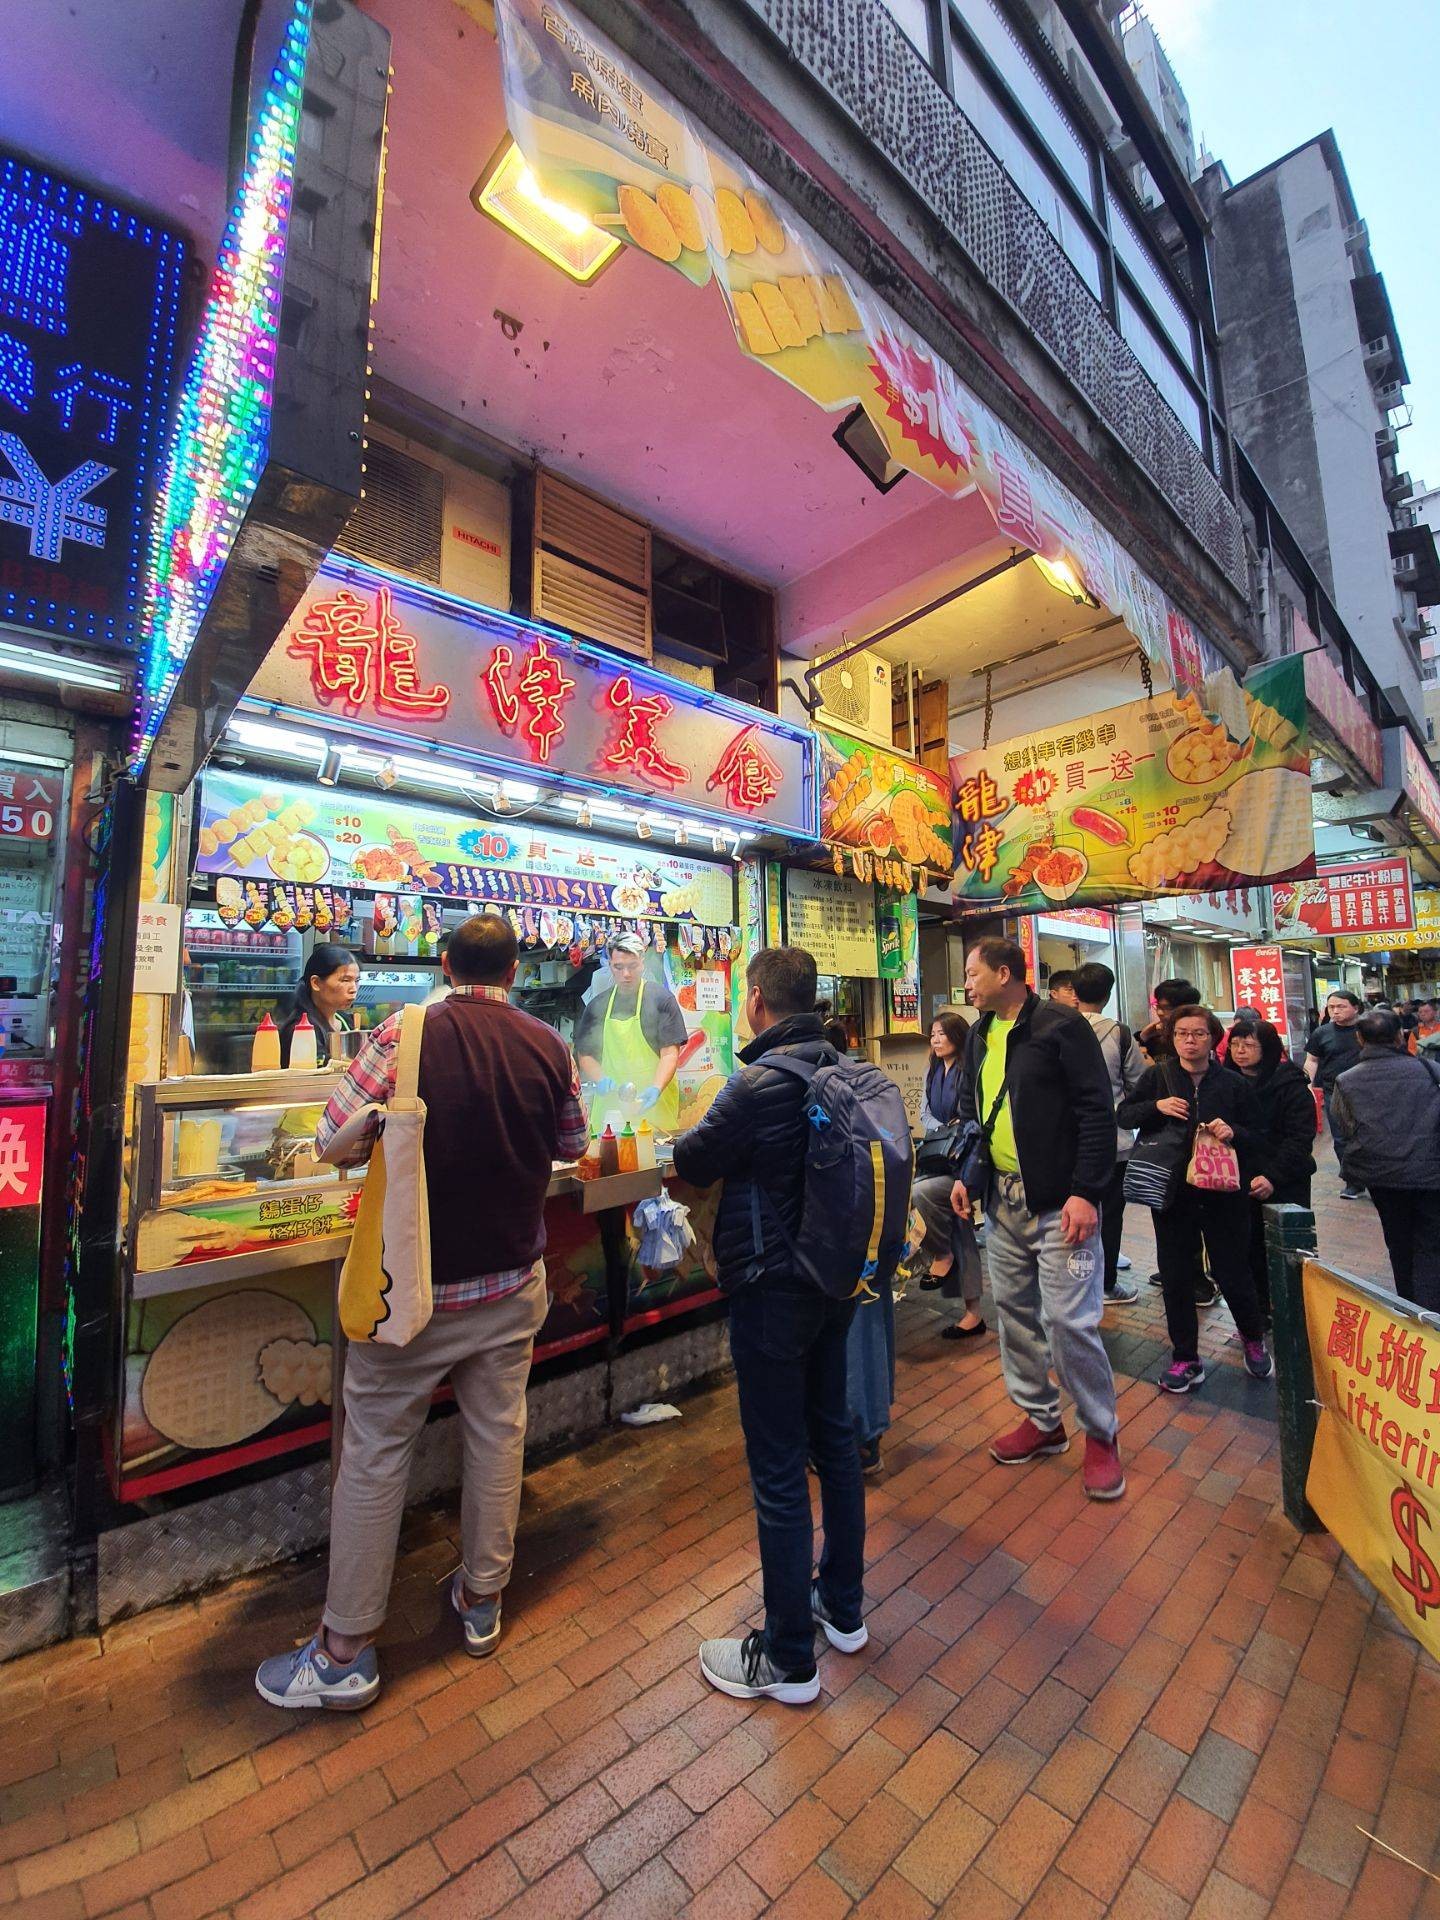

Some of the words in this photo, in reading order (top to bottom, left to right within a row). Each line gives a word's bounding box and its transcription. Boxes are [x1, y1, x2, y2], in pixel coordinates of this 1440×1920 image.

[457, 530, 497, 554] HITACHI
[290, 585, 784, 808] 龍津美食
[1003, 723, 1117, 772] 想幾串有幾串
[893, 765, 938, 792] 買一送一
[1065, 750, 1156, 793] 買一送一
[1028, 776, 1051, 800] $10
[335, 815, 362, 828] $10
[954, 771, 1009, 884] 龍津
[335, 832, 362, 845] $20
[473, 834, 509, 858] $10
[1272, 886, 1328, 908] Cocola
[1365, 931, 1408, 948] 2386
[1238, 966, 1281, 986] 豪記
[1194, 1156, 1237, 1177] on
